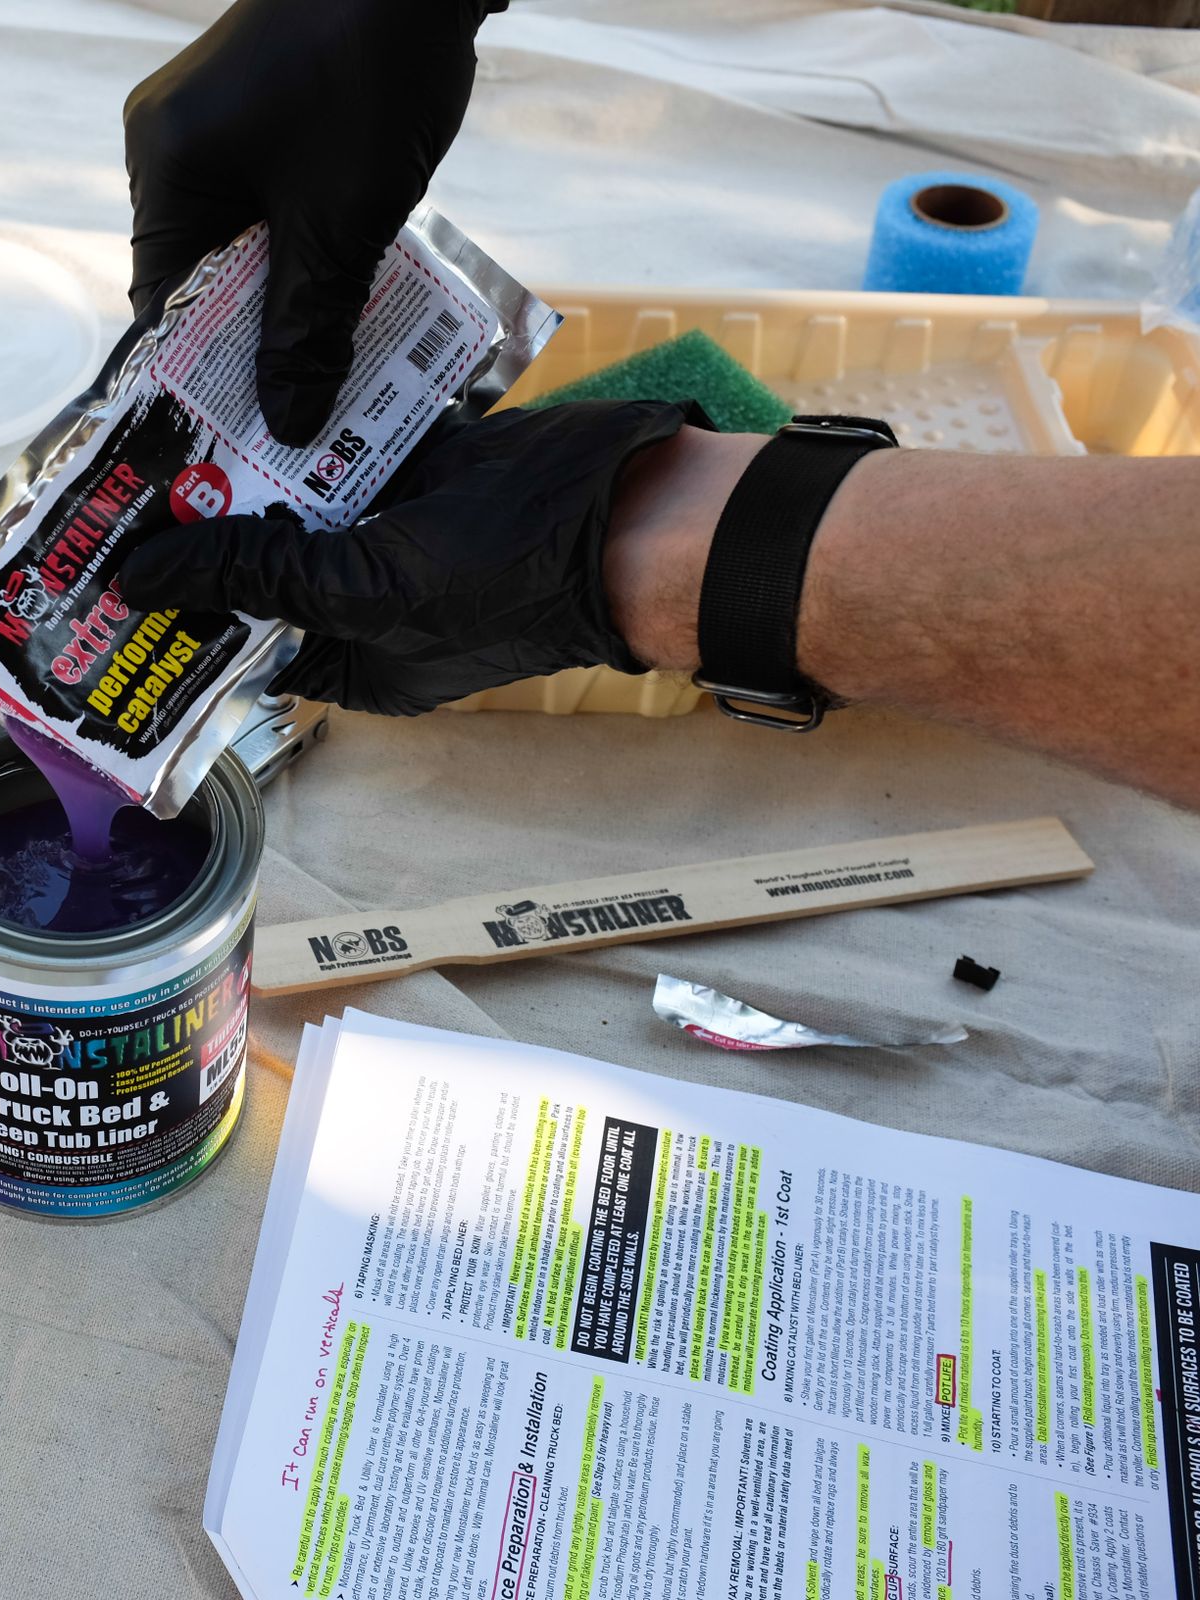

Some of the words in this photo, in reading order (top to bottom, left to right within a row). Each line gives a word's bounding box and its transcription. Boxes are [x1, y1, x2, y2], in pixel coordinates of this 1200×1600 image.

[361, 396, 382, 418] Proudly
[377, 381, 393, 398] Made
[375, 404, 386, 416] the
[382, 389, 399, 406] U.S.A.
[340, 479, 362, 504] Magnet
[358, 460, 377, 481] Paints
[378, 425, 406, 456] Amityville,
[402, 413, 412, 425] NY
[409, 395, 427, 415] 11701
[429, 341, 467, 390] 1-800-922-9981
[392, 404, 434, 456] www.monstaliner.com
[63, 500, 79, 519] TRUCK
[76, 489, 88, 503] BED
[84, 458, 114, 491] PROTECTION
[174, 470, 200, 497] Part
[132, 484, 156, 510] Liner
[185, 481, 225, 517] B
[118, 507, 138, 525] Tub
[104, 523, 125, 547] Jeep
[86, 551, 105, 573] Bed
[100, 545, 111, 555] &
[68, 570, 92, 598] Truck
[43, 596, 74, 631] Roll-On
[117, 631, 202, 735] catalyst
[138, 708, 166, 743] WARNING!
[165, 672, 196, 709] COMBUSTIBLE
[193, 654, 212, 674] LIQUID
[209, 642, 222, 657] AND
[217, 624, 236, 644] VAPOR.
[753, 876, 785, 885] World's
[787, 870, 823, 881] Toughest
[766, 867, 915, 898] www.monstaliner.com
[552, 898, 600, 911] DO-IT-YOURSELF
[601, 895, 620, 903] TRUCK
[633, 887, 669, 899] PROTECTION
[319, 962, 337, 972] High
[336, 956, 381, 969] Performance
[381, 952, 412, 963] Coatings
[20, 1001, 30, 1011] is
[34, 1003, 85, 1015] intended
[90, 1005, 106, 1013] for
[110, 1001, 130, 1011] use
[134, 992, 157, 1006] only
[160, 987, 170, 997] in
[182, 968, 201, 986] well
[79, 1018, 150, 1038] DO-IT-YOURSELF
[152, 1007, 177, 1023] TRUCK
[179, 999, 193, 1011] BED
[194, 966, 230, 1001] PROTECTION
[115, 1069, 138, 1079] 100%
[139, 1064, 150, 1073] UV
[151, 1044, 192, 1069] Permanent
[116, 1078, 135, 1088] Easy
[136, 1059, 180, 1082] Installation
[116, 1074, 167, 1096] Professional
[168, 1059, 194, 1079] Results
[79, 1096, 142, 1127] Bed
[149, 1090, 170, 1112] &
[43, 1130, 92, 1149] Tub
[97, 1118, 158, 1147] Liner
[605, 1126, 620, 1152] UNTIL
[622, 1130, 636, 1147] ALL
[27, 1151, 113, 1166] COMBUSTIBLE
[600, 1154, 615, 1184] FLOOR
[618, 1146, 633, 1171] COAT
[615, 1171, 630, 1192] ONE
[775, 1169, 792, 1203] Coat
[597, 1186, 611, 1206] BED
[611, 1192, 627, 1223] LEAST
[593, 1207, 608, 1226] THE
[774, 1205, 789, 1226] 1st
[455, 1220, 467, 1247] LINER:
[609, 1222, 623, 1237] AT
[355, 1215, 379, 1288] TAPING/MASKING:
[451, 1247, 463, 1266] BED
[587, 1228, 605, 1271] COATING
[623, 1231, 639, 1266] WALLS.
[793, 1242, 804, 1271] LINER:
[601, 1238, 620, 1297] COMPLETED
[619, 1266, 634, 1290] SIDE
[766, 1240, 786, 1321] Application
[791, 1270, 802, 1290] BED
[353, 1289, 364, 1299] 6)
[443, 1266, 459, 1311] APPLYING
[582, 1273, 598, 1305] BEGIN
[1173, 1262, 1192, 1307] COATED
[597, 1298, 612, 1327] HAVE
[616, 1289, 631, 1310] THE
[790, 1289, 800, 1313] WITH
[319, 1282, 344, 1357] verticals
[347, 1321, 356, 1333] on
[440, 1310, 452, 1320] 7)
[579, 1306, 593, 1329] NOT
[1176, 1309, 1194, 1325] BE
[576, 1330, 590, 1347] DO
[593, 1327, 608, 1349] YOU
[611, 1311, 628, 1355] AROUND
[786, 1313, 798, 1358] CATALYST
[1177, 1327, 1195, 1343] TO
[338, 1332, 355, 1369] especially
[760, 1323, 783, 1381] Coating
[314, 1367, 328, 1388] on
[334, 1370, 346, 1390] area,
[784, 1359, 795, 1393] MIXING
[941, 1358, 952, 1382] LIFE:
[1179, 1346, 1200, 1411] SURFACES
[331, 1390, 342, 1406] one
[783, 1392, 794, 1403] 8)
[940, 1381, 951, 1402] POT
[304, 1395, 319, 1420] run
[328, 1406, 338, 1415] in
[520, 1371, 547, 1457] Installation
[940, 1402, 952, 1432] MIXED
[321, 1415, 338, 1445] coating
[940, 1432, 951, 1443] 9)
[317, 1445, 329, 1468] much
[517, 1461, 533, 1474] &
[281, 1461, 299, 1491] It
[312, 1469, 324, 1483] too
[307, 1484, 322, 1507] apply
[303, 1517, 313, 1533] not
[305, 1507, 316, 1518] to
[501, 1477, 535, 1574] Preparation
[297, 1533, 310, 1563] careful
[292, 1563, 304, 1577] Be
